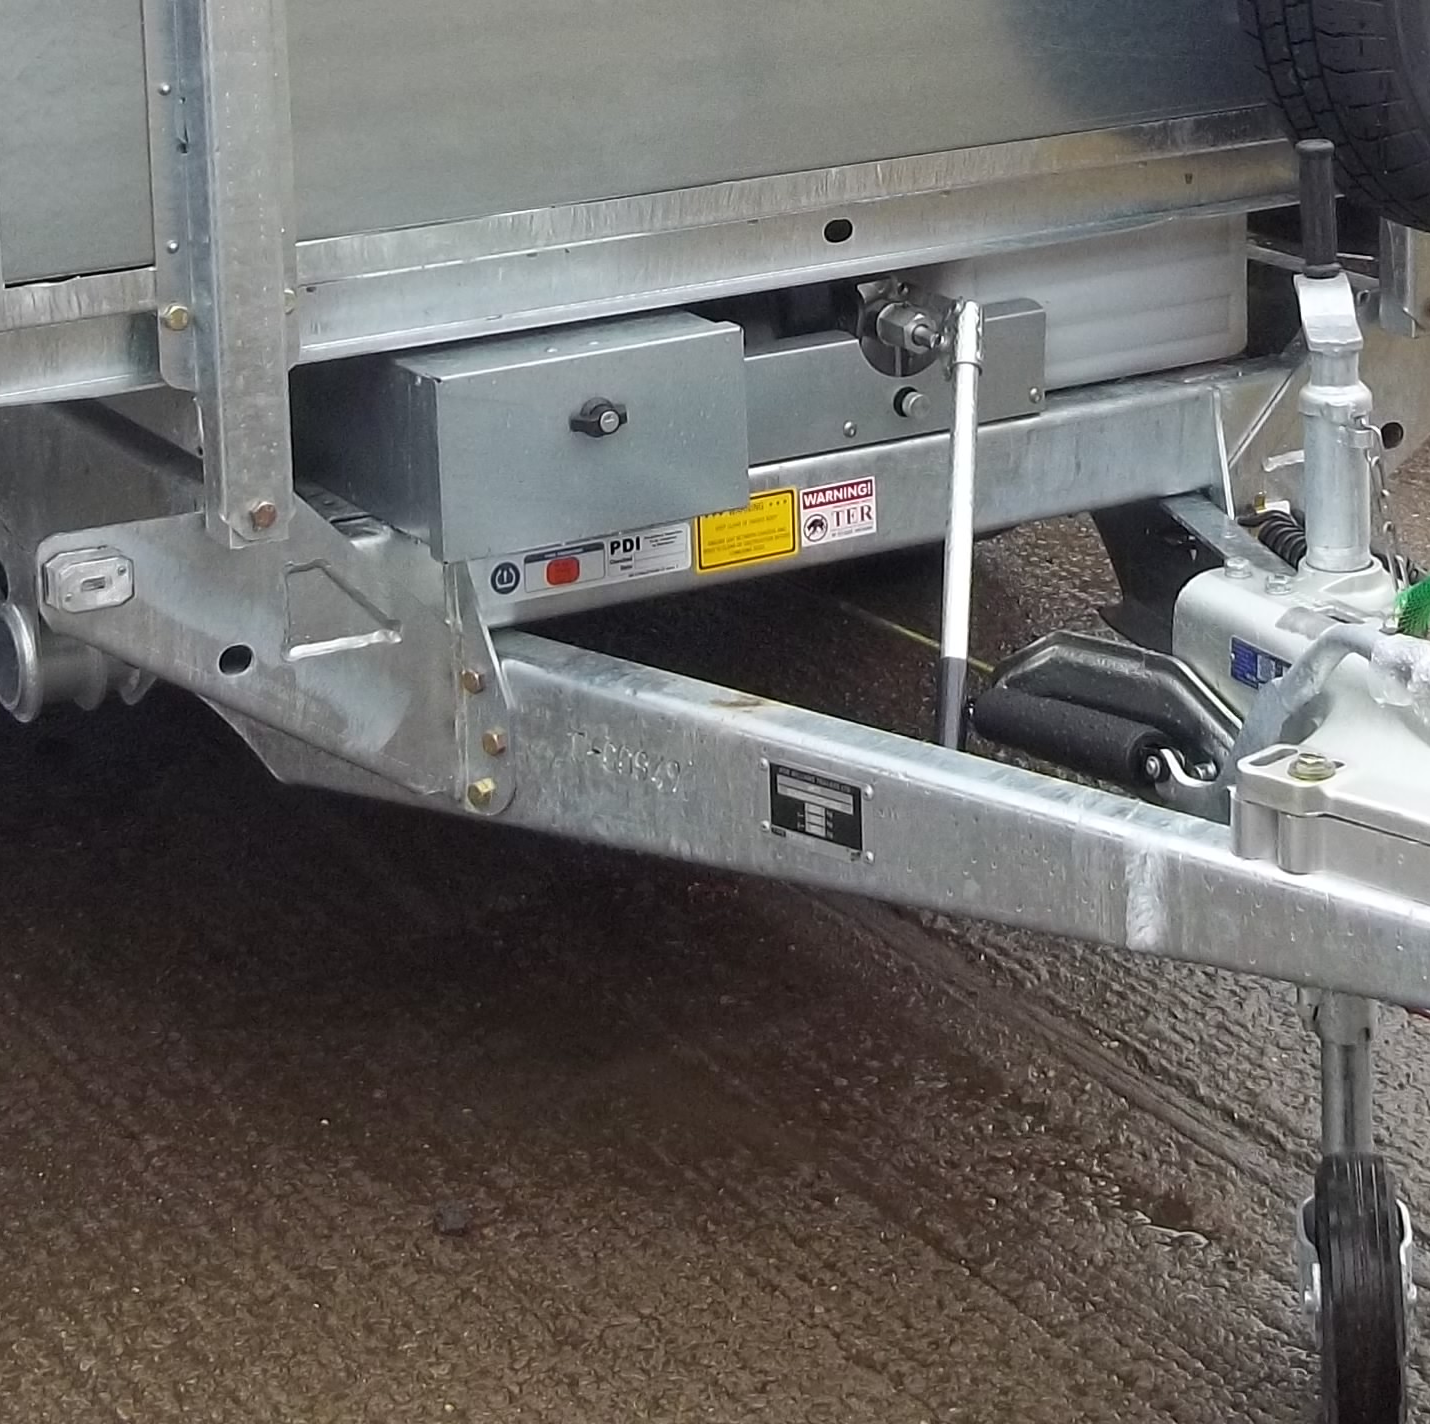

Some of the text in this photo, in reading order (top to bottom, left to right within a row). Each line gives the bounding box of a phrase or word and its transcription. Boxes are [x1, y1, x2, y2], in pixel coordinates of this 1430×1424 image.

[803, 482, 872, 508] WARNING!
[832, 504, 873, 528] TER
[610, 536, 641, 556] PDI
